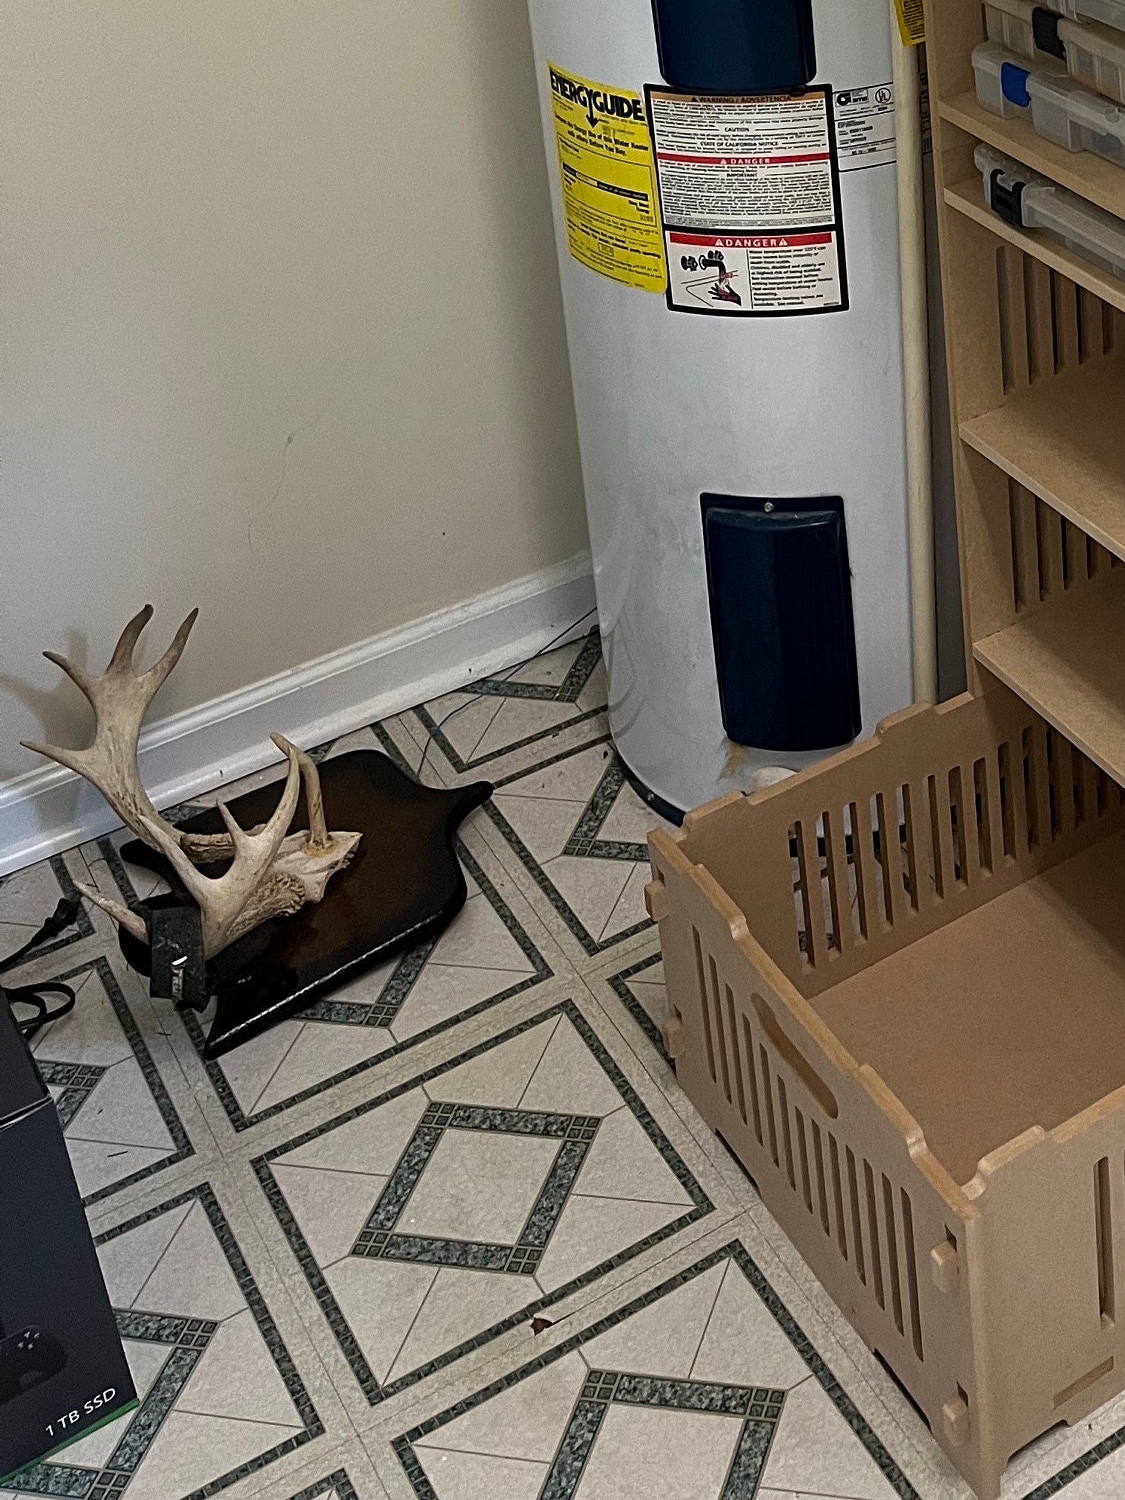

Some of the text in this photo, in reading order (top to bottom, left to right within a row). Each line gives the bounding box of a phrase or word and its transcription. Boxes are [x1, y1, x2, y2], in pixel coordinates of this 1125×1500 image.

[725, 238, 777, 247] DANGER
[45, 1387, 116, 1436] 1 TB SSD
